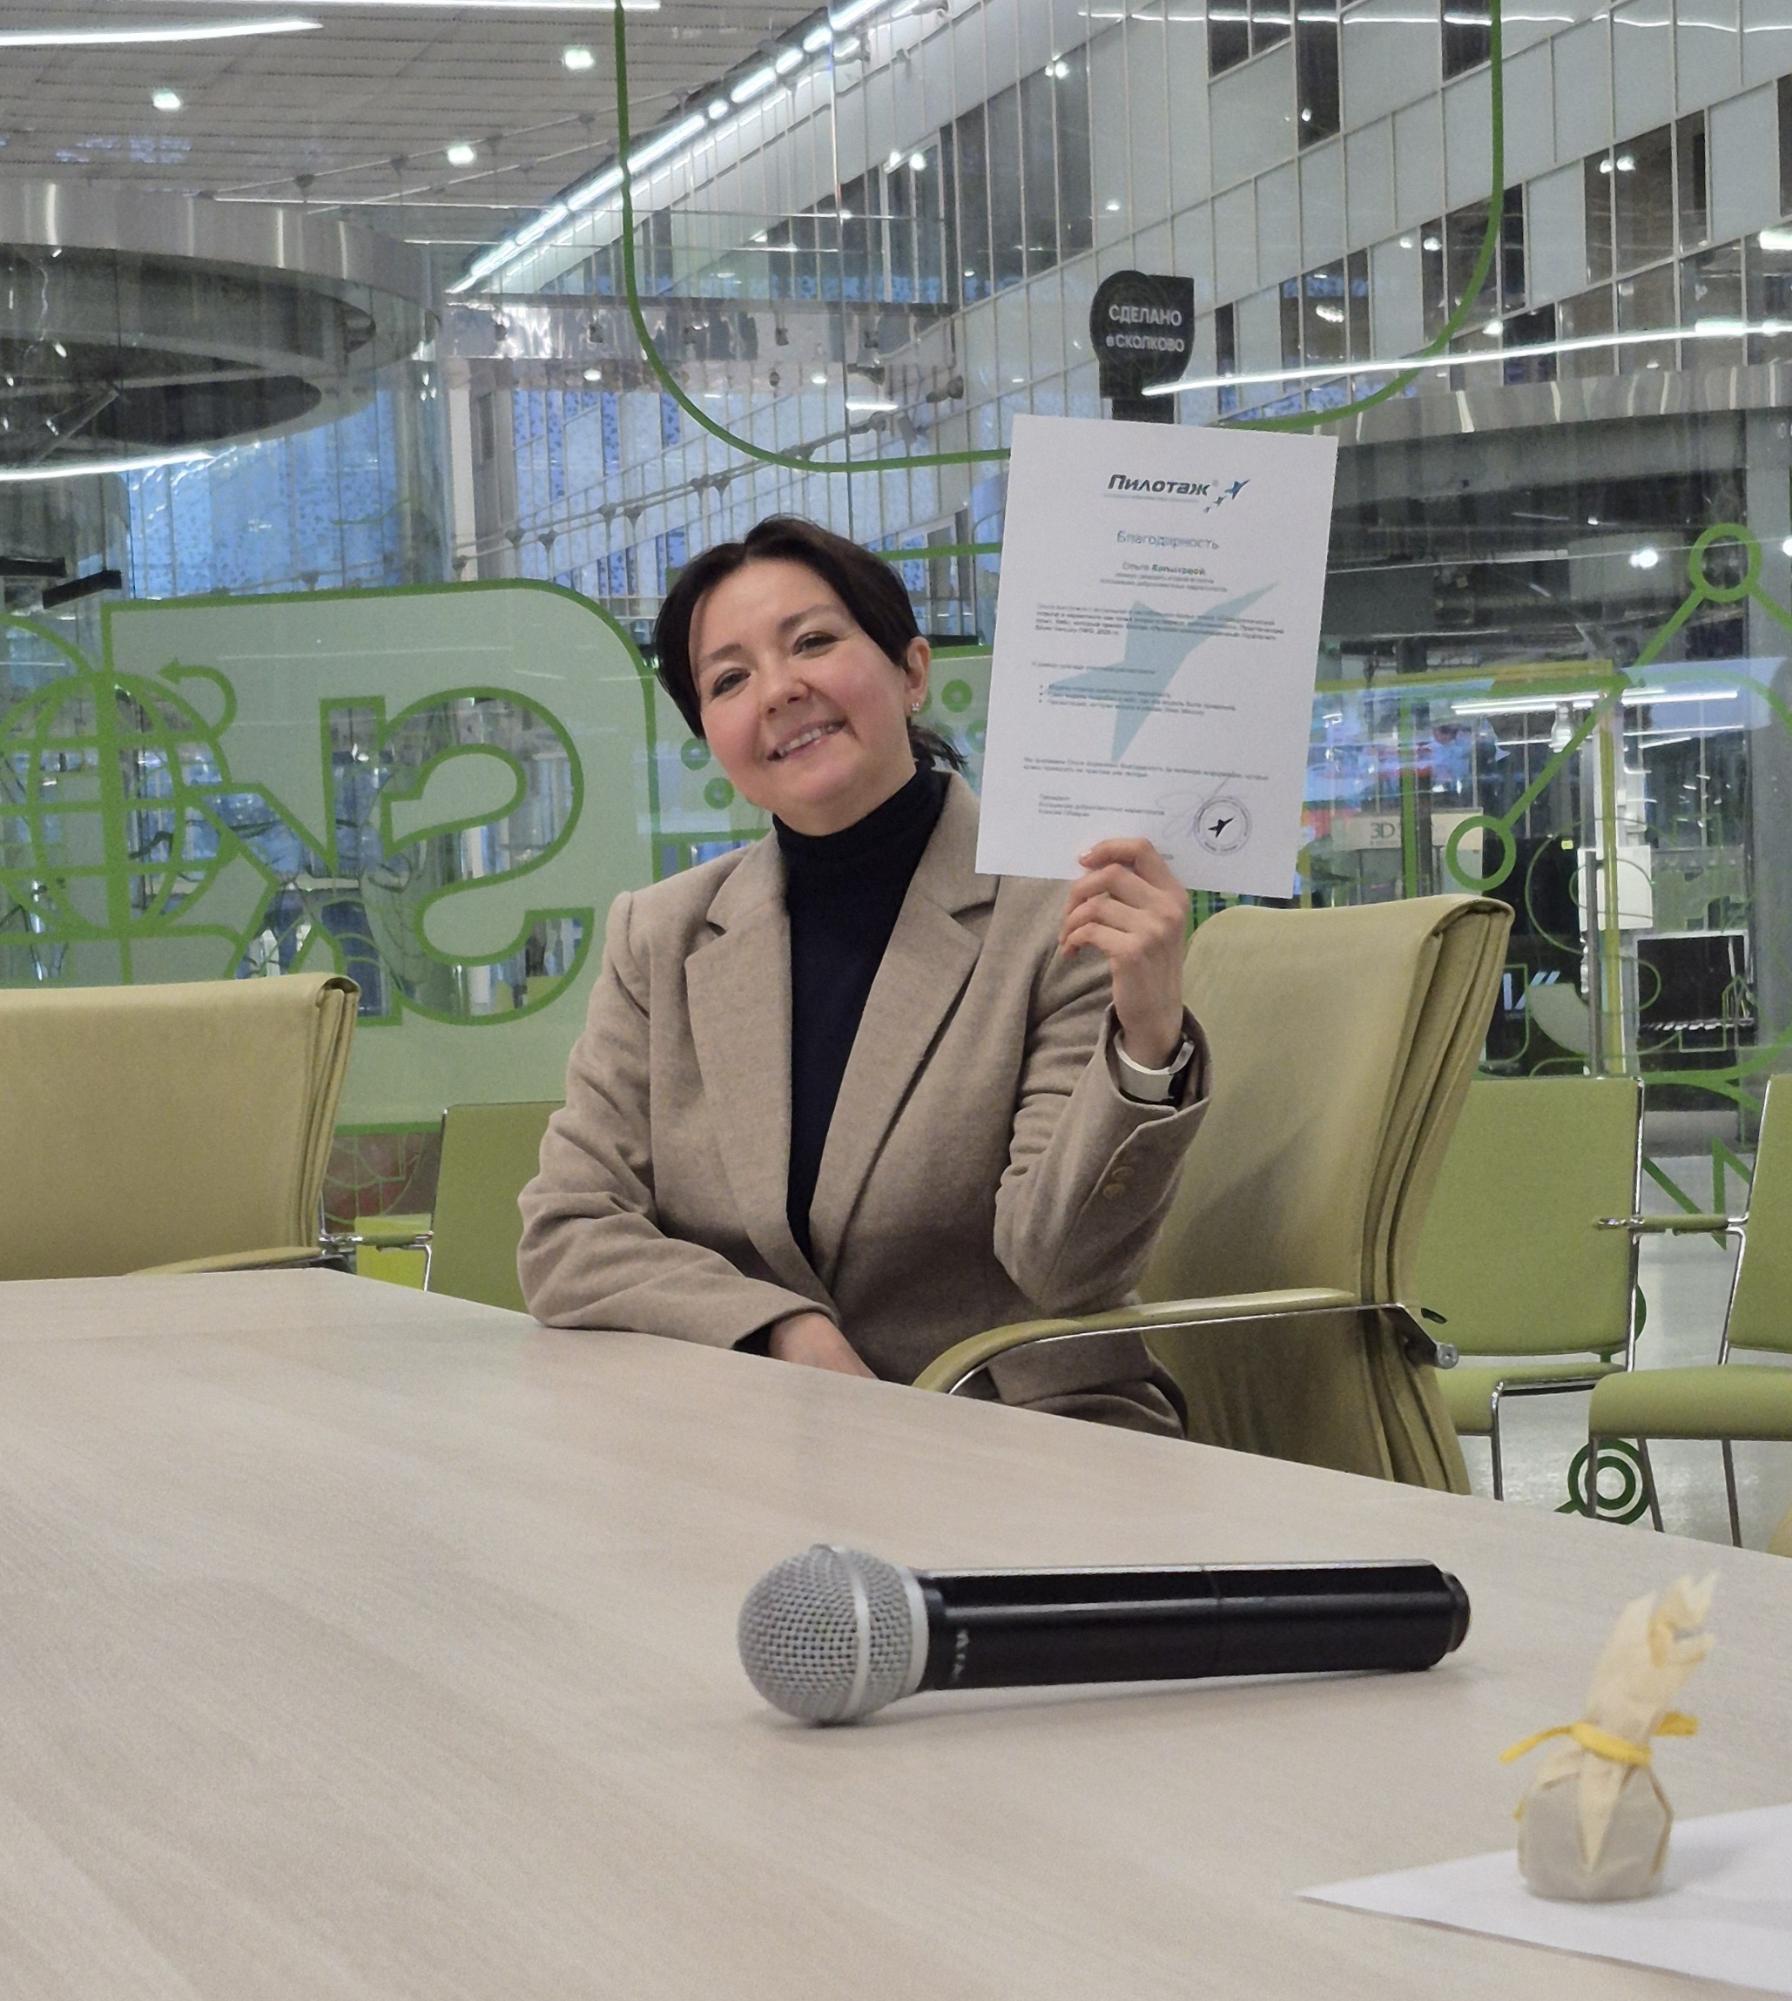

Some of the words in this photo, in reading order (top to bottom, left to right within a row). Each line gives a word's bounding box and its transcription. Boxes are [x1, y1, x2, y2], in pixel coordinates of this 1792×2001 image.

[1109, 304, 1182, 327] СДЕЛАНО
[1115, 334, 1185, 353] СКОЛКОВО
[1107, 474, 1210, 496] Пилотаж
